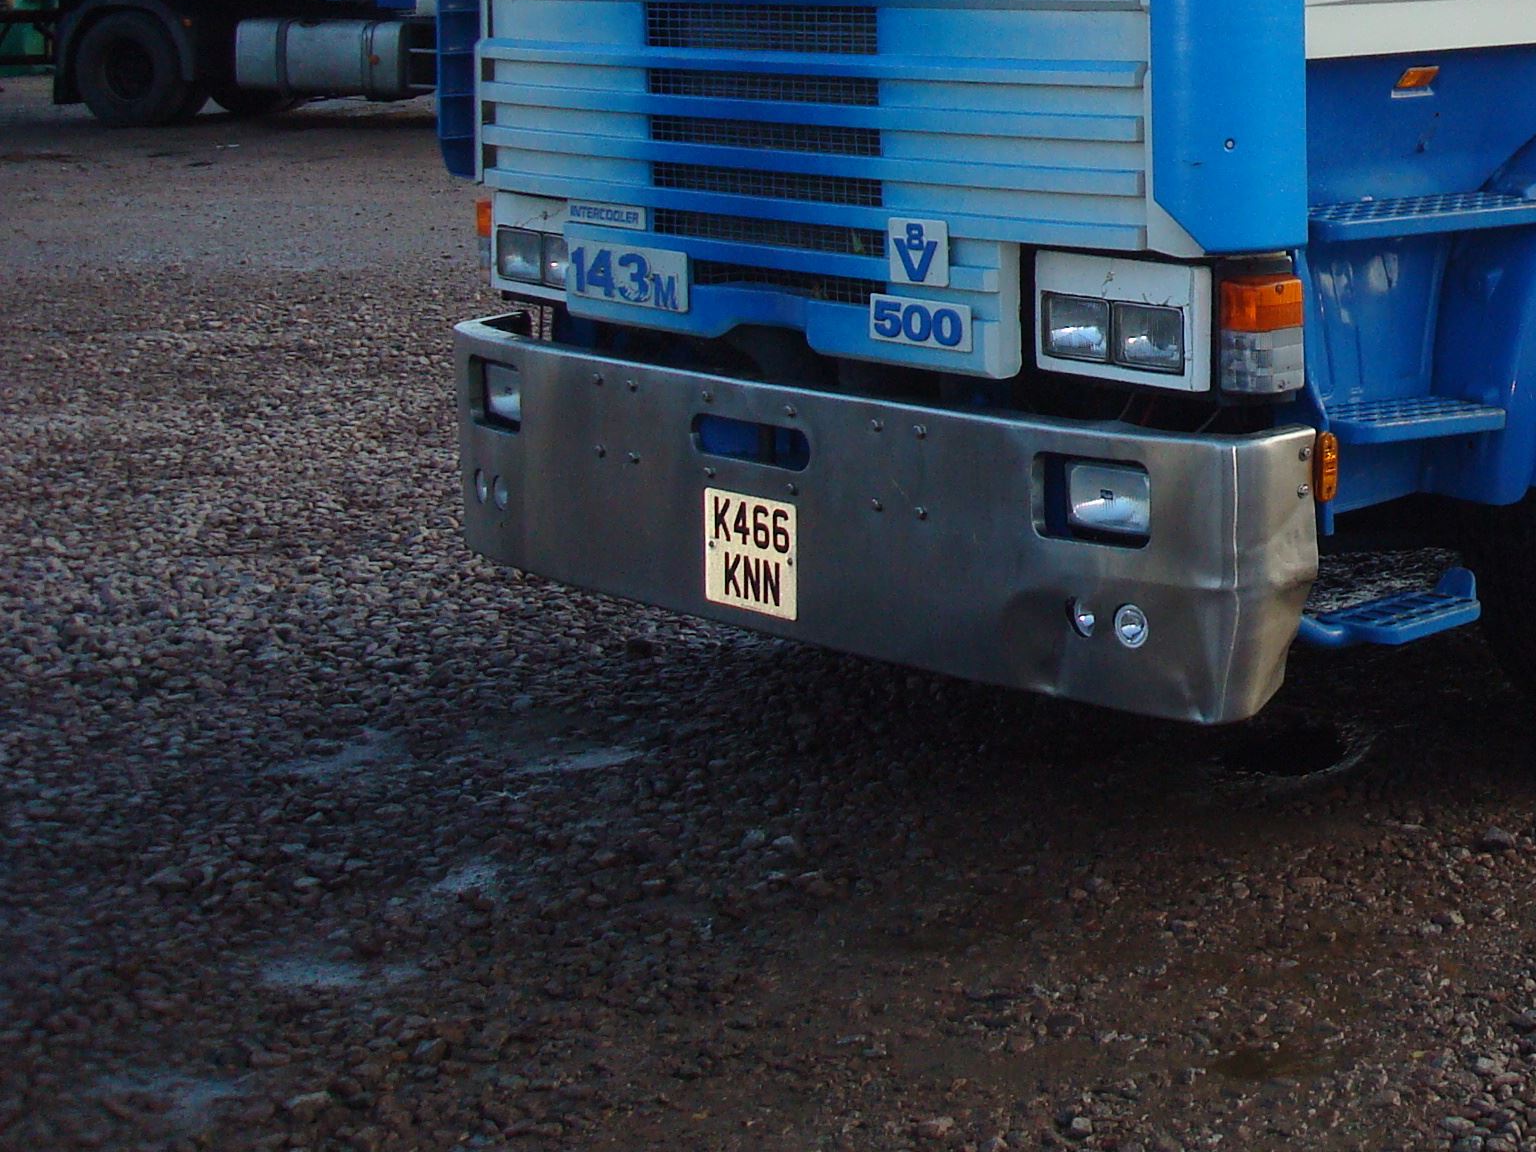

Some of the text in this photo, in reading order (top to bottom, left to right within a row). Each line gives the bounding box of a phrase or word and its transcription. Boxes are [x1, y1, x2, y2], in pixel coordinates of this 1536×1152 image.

[570, 205, 640, 225] INTERCOOLER
[873, 299, 963, 347] 500
[714, 495, 790, 554] K466
[724, 551, 780, 607] KNN
